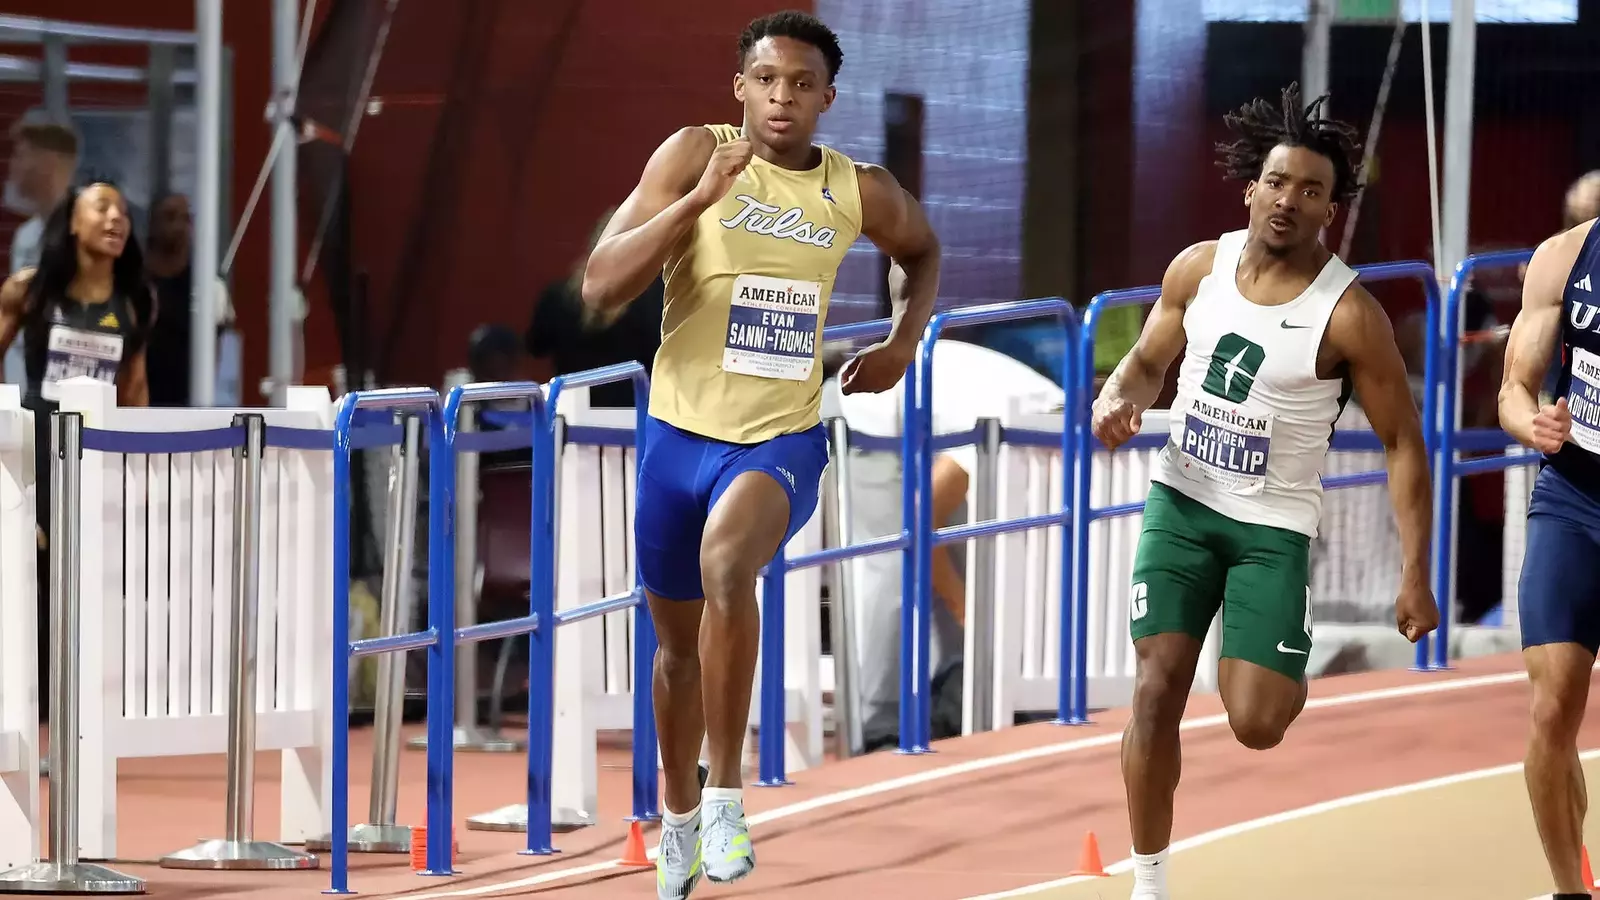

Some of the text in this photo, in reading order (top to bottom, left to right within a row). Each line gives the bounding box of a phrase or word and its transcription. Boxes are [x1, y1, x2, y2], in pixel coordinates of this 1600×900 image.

[719, 194, 837, 249] Tulsa
[739, 286, 816, 307] AMERICAN
[762, 311, 795, 328] EVAN
[729, 322, 815, 354] SANNI-THOMAS
[1192, 399, 1268, 431] AMERICAN
[1186, 429, 1265, 472] PHILLIP
[1202, 425, 1247, 448] JAYDEN
